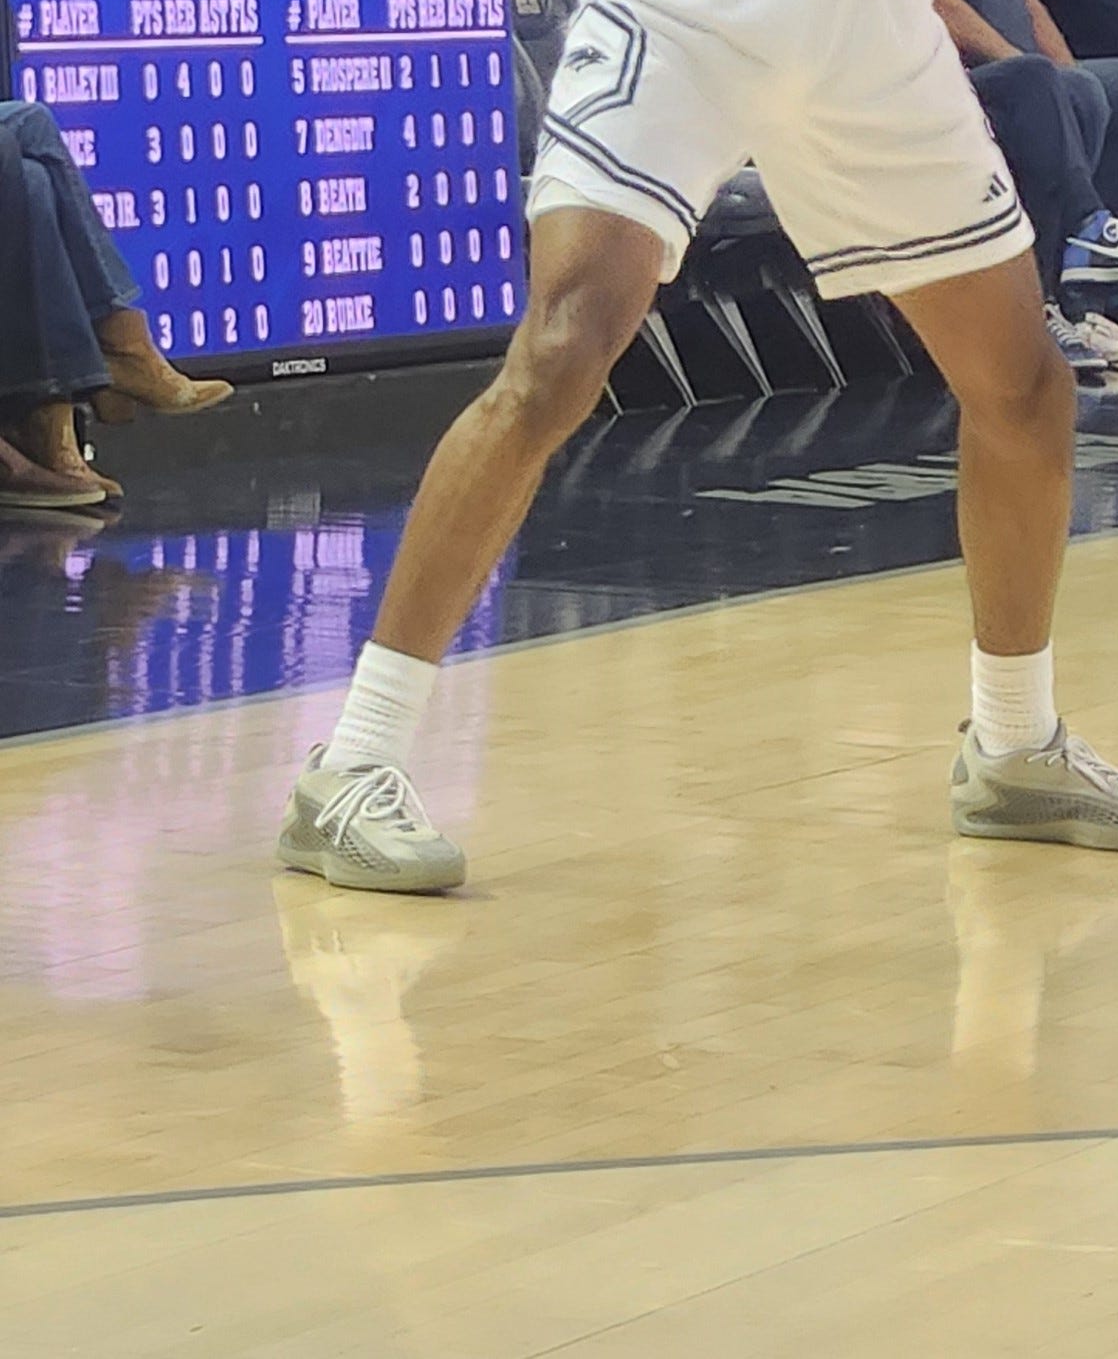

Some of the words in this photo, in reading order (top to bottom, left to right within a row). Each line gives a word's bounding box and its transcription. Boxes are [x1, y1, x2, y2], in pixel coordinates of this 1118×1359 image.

[40, 0, 99, 36] PLAYER
[130, 0, 162, 35] PTS
[164, 0, 195, 34] REB
[23, 67, 36, 103] 0
[44, 65, 98, 103] BAILEY
[145, 63, 158, 100] 0
[177, 62, 190, 97] 4
[210, 61, 222, 97] 0
[241, 60, 254, 96] 0
[292, 58, 305, 94] 5
[400, 55, 413, 89] 2
[431, 54, 440, 88] 1
[460, 53, 469, 87] 1
[489, 52, 500, 86] 0
[146, 126, 161, 163] 3
[181, 124, 193, 161] 0
[213, 123, 226, 159] 0
[245, 122, 257, 158] 0
[296, 120, 308, 154] 7
[404, 114, 416, 148] 4
[433, 113, 445, 147] 0
[462, 111, 474, 145] 0
[492, 110, 503, 143] 0
[152, 190, 165, 226] 3
[186, 187, 196, 223] 1
[217, 185, 229, 221] 0
[249, 183, 261, 219] 0
[300, 181, 312, 216] 8
[318, 177, 366, 214] BEATH
[407, 173, 419, 208] 2
[436, 171, 448, 206] 0
[465, 170, 477, 204] 0
[495, 168, 507, 202] 0
[155, 252, 168, 289] 0
[188, 250, 200, 287] 0
[222, 248, 231, 283] 1
[251, 245, 264, 281] 0
[304, 241, 315, 276] 9
[322, 236, 382, 274] BEATTIE
[411, 233, 423, 268] 0
[439, 231, 451, 264] 0
[468, 228, 480, 262] 0
[499, 225, 510, 259] 0
[159, 313, 172, 350] 3
[192, 311, 205, 347] 0
[224, 307, 237, 343] 2
[255, 304, 268, 340] 0
[303, 300, 323, 336] 20
[326, 295, 374, 333] BURKE
[415, 290, 427, 325] 0
[443, 287, 455, 321] 0
[472, 284, 484, 319] 0
[502, 281, 514, 315] 0
[272, 357, 327, 377] DAKTRONICS
